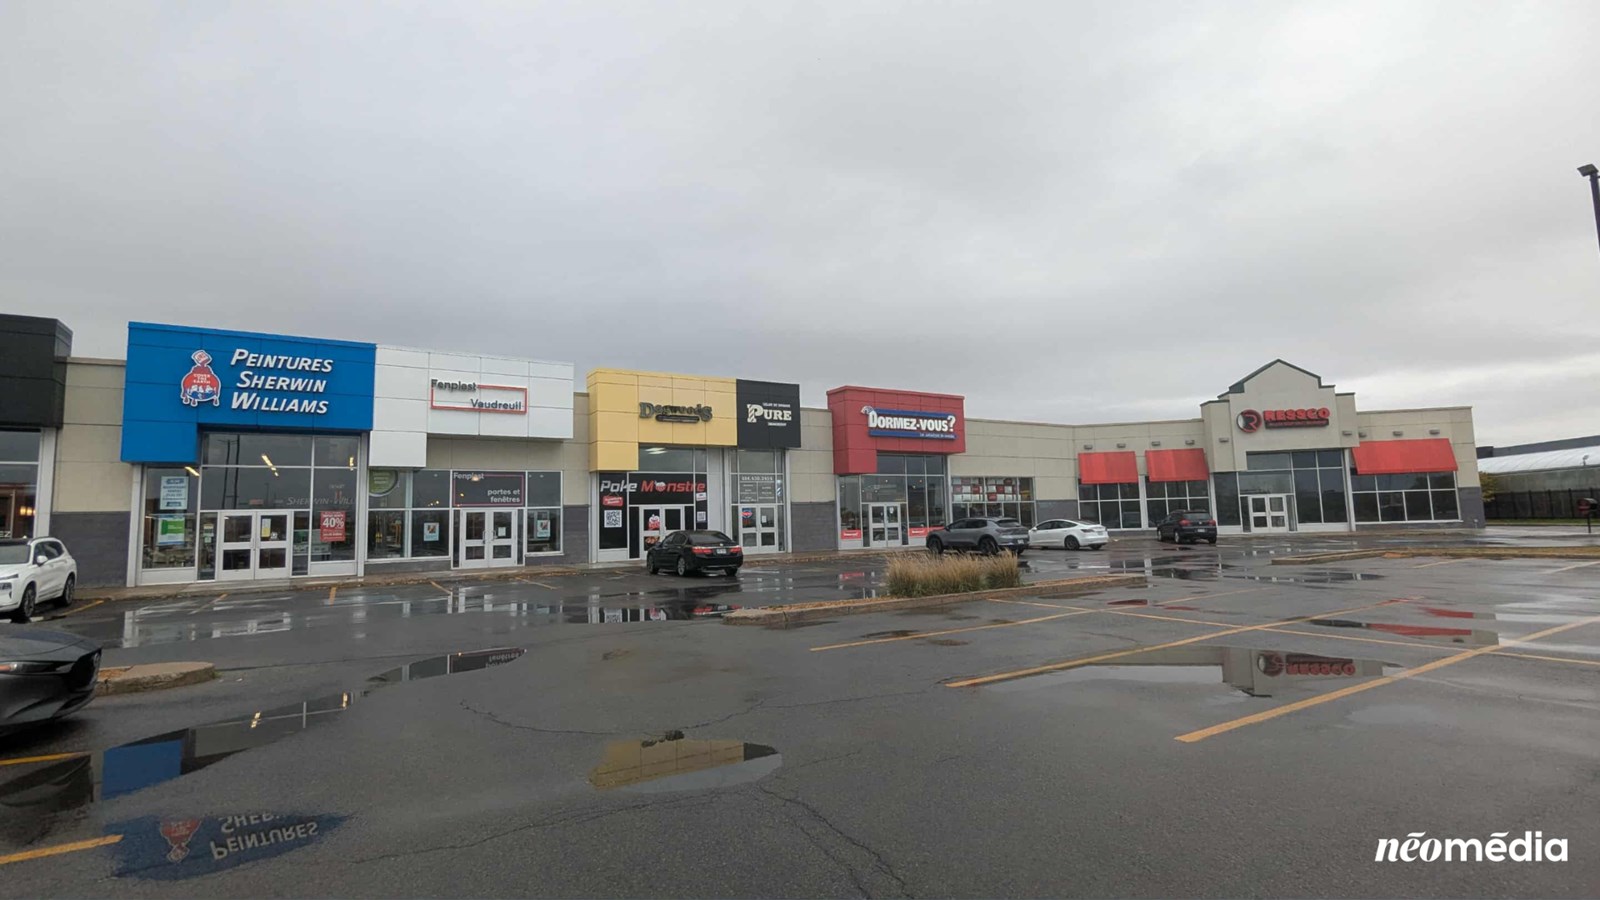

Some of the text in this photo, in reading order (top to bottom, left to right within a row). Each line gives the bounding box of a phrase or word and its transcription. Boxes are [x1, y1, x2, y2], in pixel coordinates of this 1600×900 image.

[230, 348, 334, 373] PEINTURES
[236, 371, 327, 393] SHERWIN
[431, 379, 476, 392] Fenplast
[231, 391, 329, 414] WILLIAMS
[470, 398, 522, 411] Vaudreuil
[747, 404, 792, 423] PURE
[1263, 407, 1330, 421] RESSCO
[868, 410, 956, 432] DORMEZ-VOUS?
[453, 472, 485, 480] Fenplst
[600, 480, 638, 492] Poke
[323, 517, 345, 529] 40%
